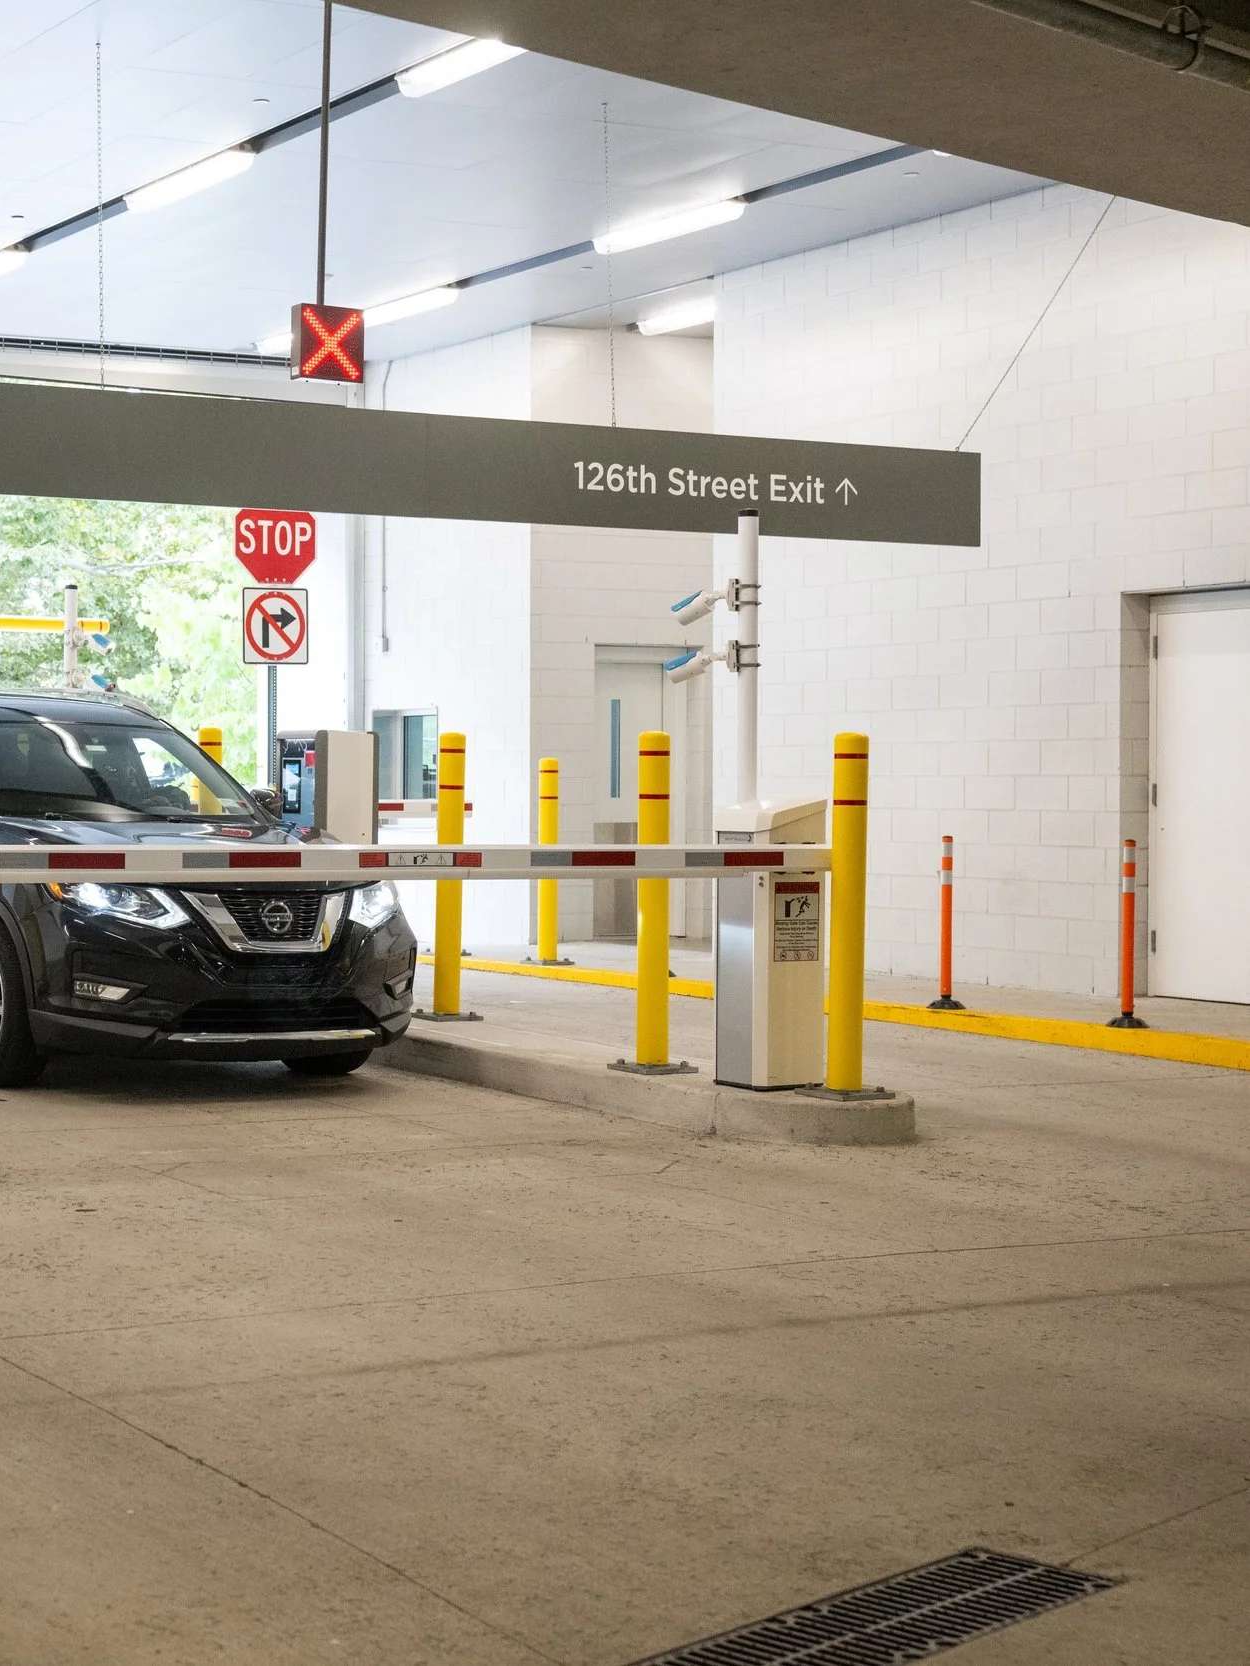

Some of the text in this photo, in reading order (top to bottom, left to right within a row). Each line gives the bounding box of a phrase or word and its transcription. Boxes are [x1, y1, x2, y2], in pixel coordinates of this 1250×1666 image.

[574, 461, 825, 504] 126th Street Exit
[239, 518, 312, 556] STOP
[783, 883, 818, 892] WARNING
